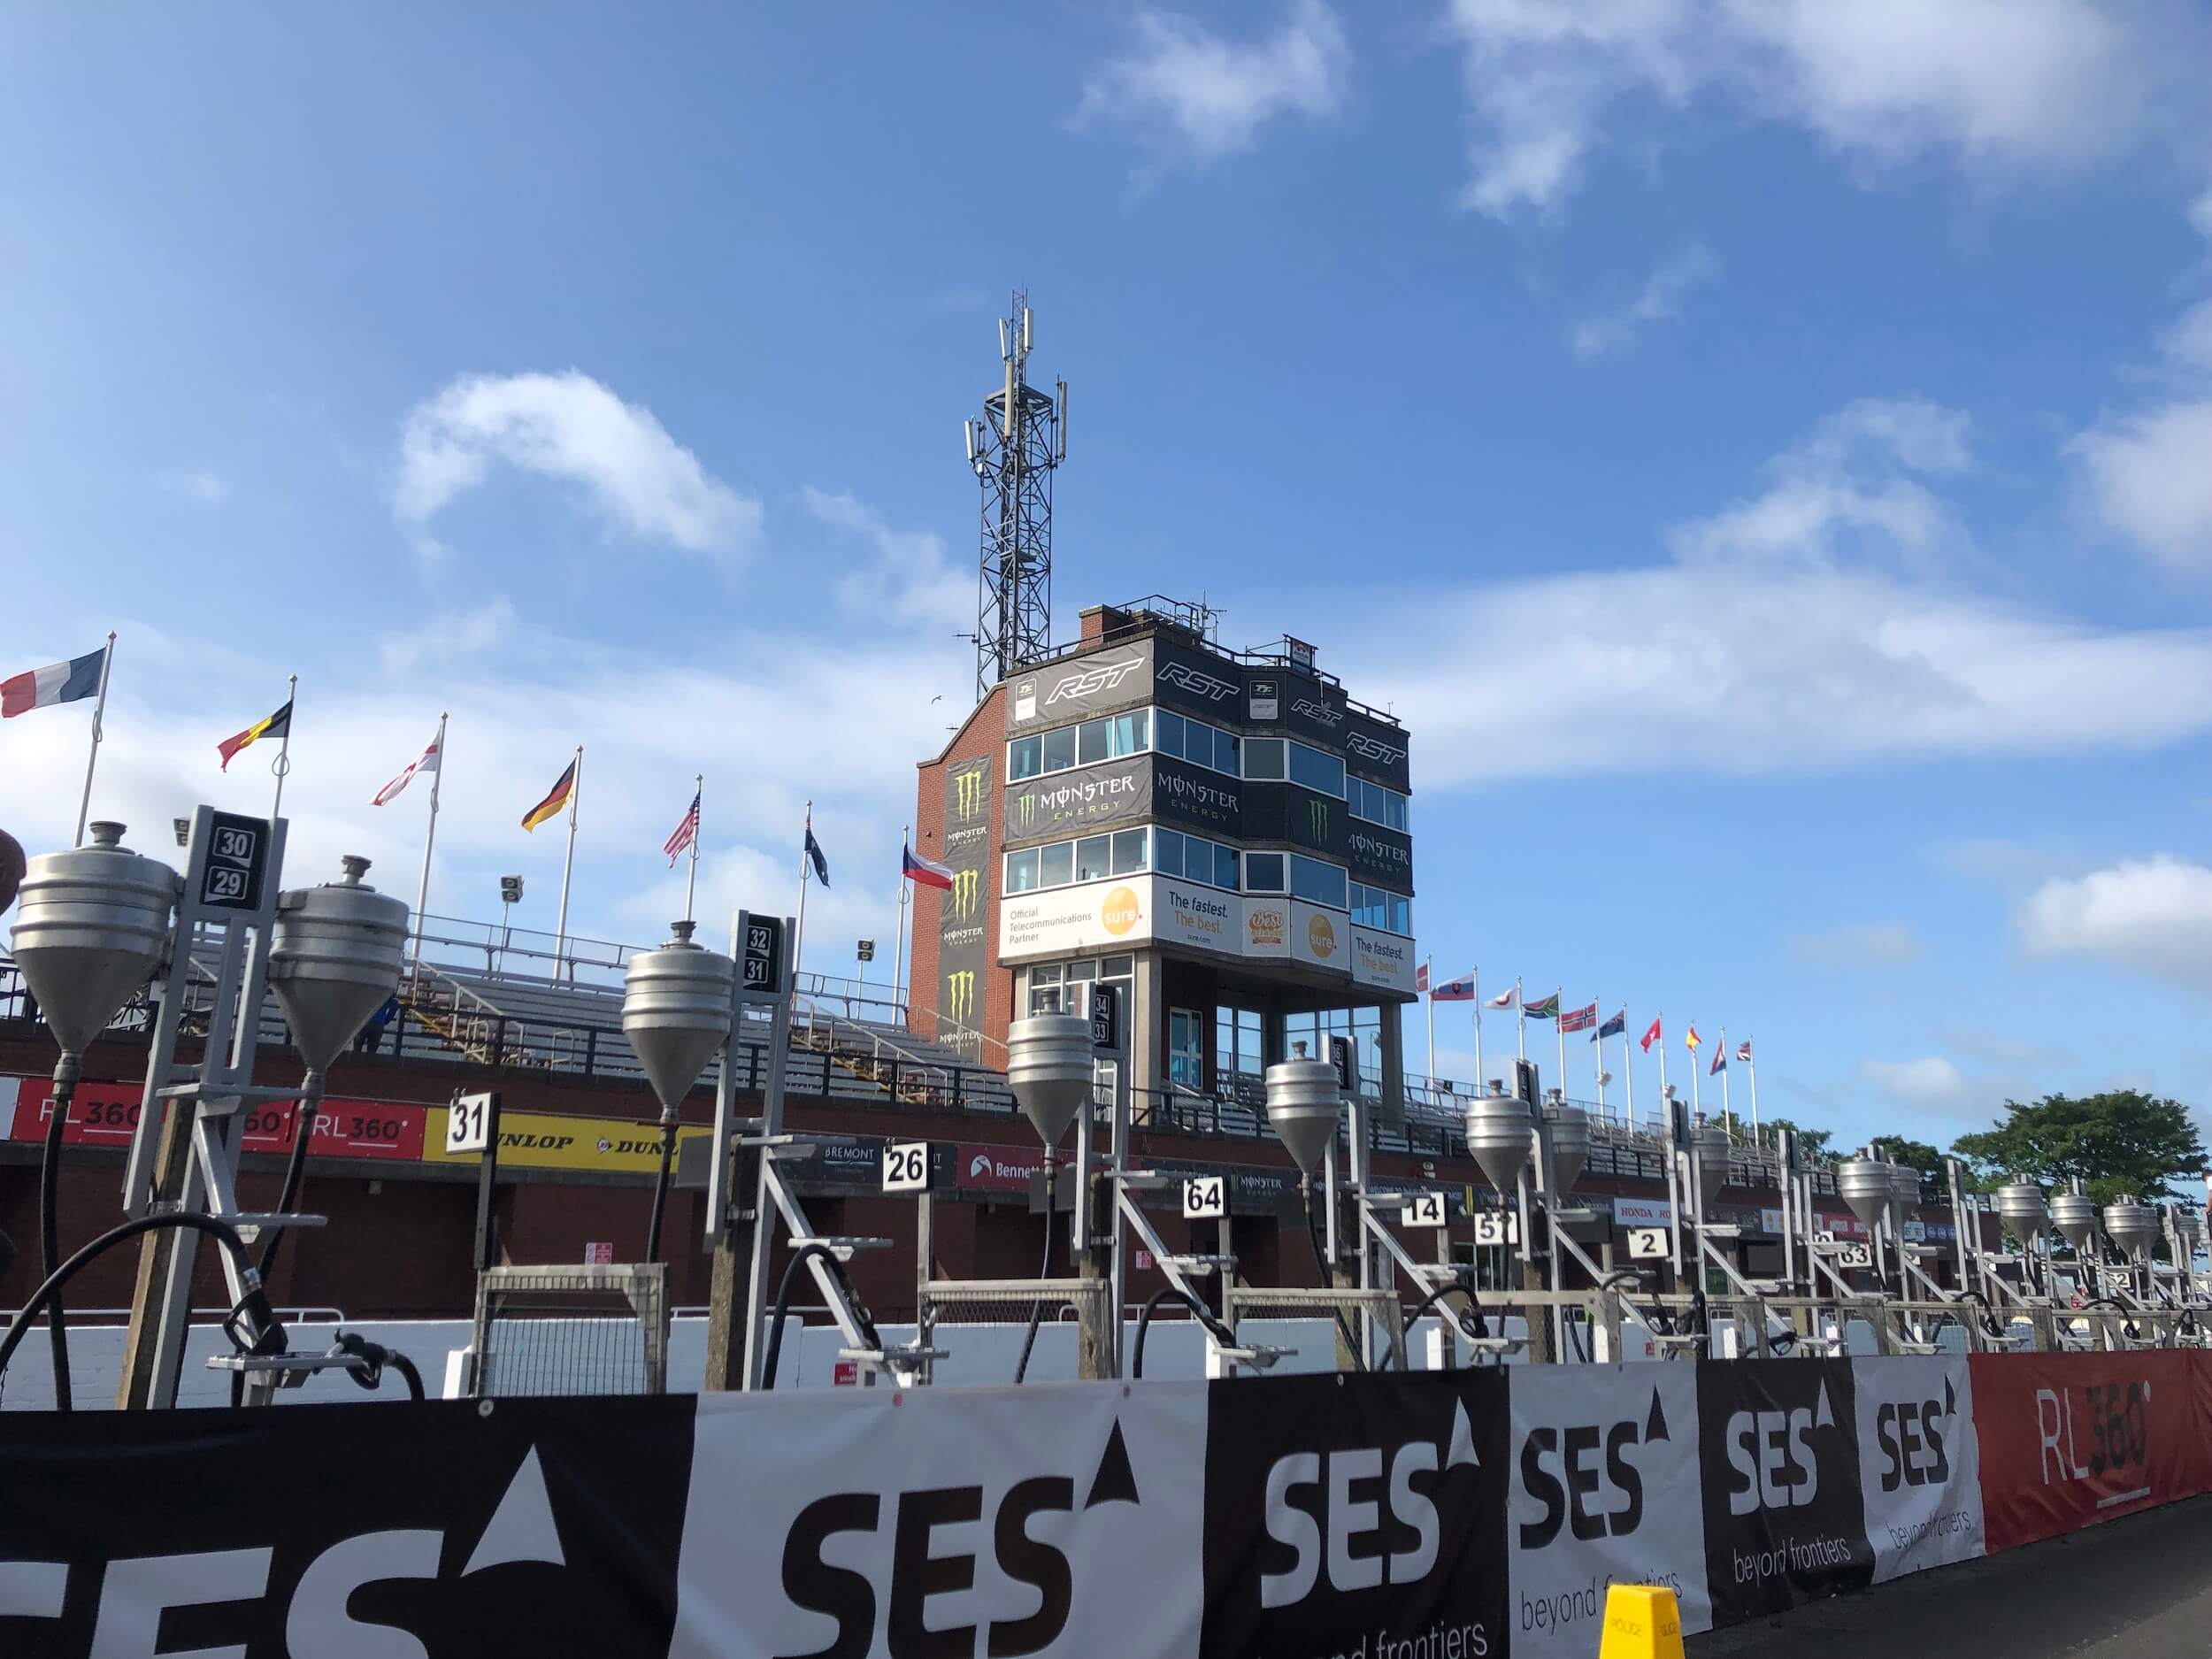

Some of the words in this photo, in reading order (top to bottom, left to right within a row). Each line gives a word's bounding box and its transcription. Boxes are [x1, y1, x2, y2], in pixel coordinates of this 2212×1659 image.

[1044, 657, 1146, 705] RST
[1156, 662, 1240, 701] RST
[1291, 698, 1343, 722] RST
[1346, 732, 1407, 764] RST
[1041, 775, 1135, 809] MONSTER
[1158, 772, 1239, 813] MONSTER
[1054, 800, 1121, 820] ENERGY
[1171, 799, 1228, 822] ENERGY
[221, 832, 249, 856] 30
[948, 826, 987, 841] MONSTER
[215, 870, 241, 895] 29
[1010, 907, 1038, 921] Official
[1169, 891, 1189, 910] The
[1191, 897, 1228, 918] fastest.
[943, 926, 983, 941] MONSTER
[1010, 912, 1092, 932] Telecommunications
[1175, 910, 1194, 927] The
[1198, 915, 1223, 934] best.
[749, 929, 766, 949] 32
[1010, 933, 1039, 944] Partner
[1356, 937, 1371, 953] The
[748, 961, 763, 979] 31
[1095, 996, 1107, 1012] 34
[1094, 1023, 1106, 1039] 33
[452, 1101, 483, 1142] 31
[497, 1133, 573, 1149] NLOP
[825, 1147, 874, 1159] BREMONT
[887, 1149, 923, 1182] 26
[1187, 1181, 1221, 1210] 64
[1621, 1206, 1653, 1218] HONDA
[1641, 1233, 1656, 1253] 2
[1877, 1400, 1948, 1493] SES
[1726, 1408, 1817, 1515] SES
[1520, 1421, 1643, 1549] SES
[1261, 1441, 1440, 1609] SES
[1789, 1533, 1851, 1571] frontiers
[772, 1475, 1073, 1659] SES
[1521, 1578, 1597, 1635] beyond
